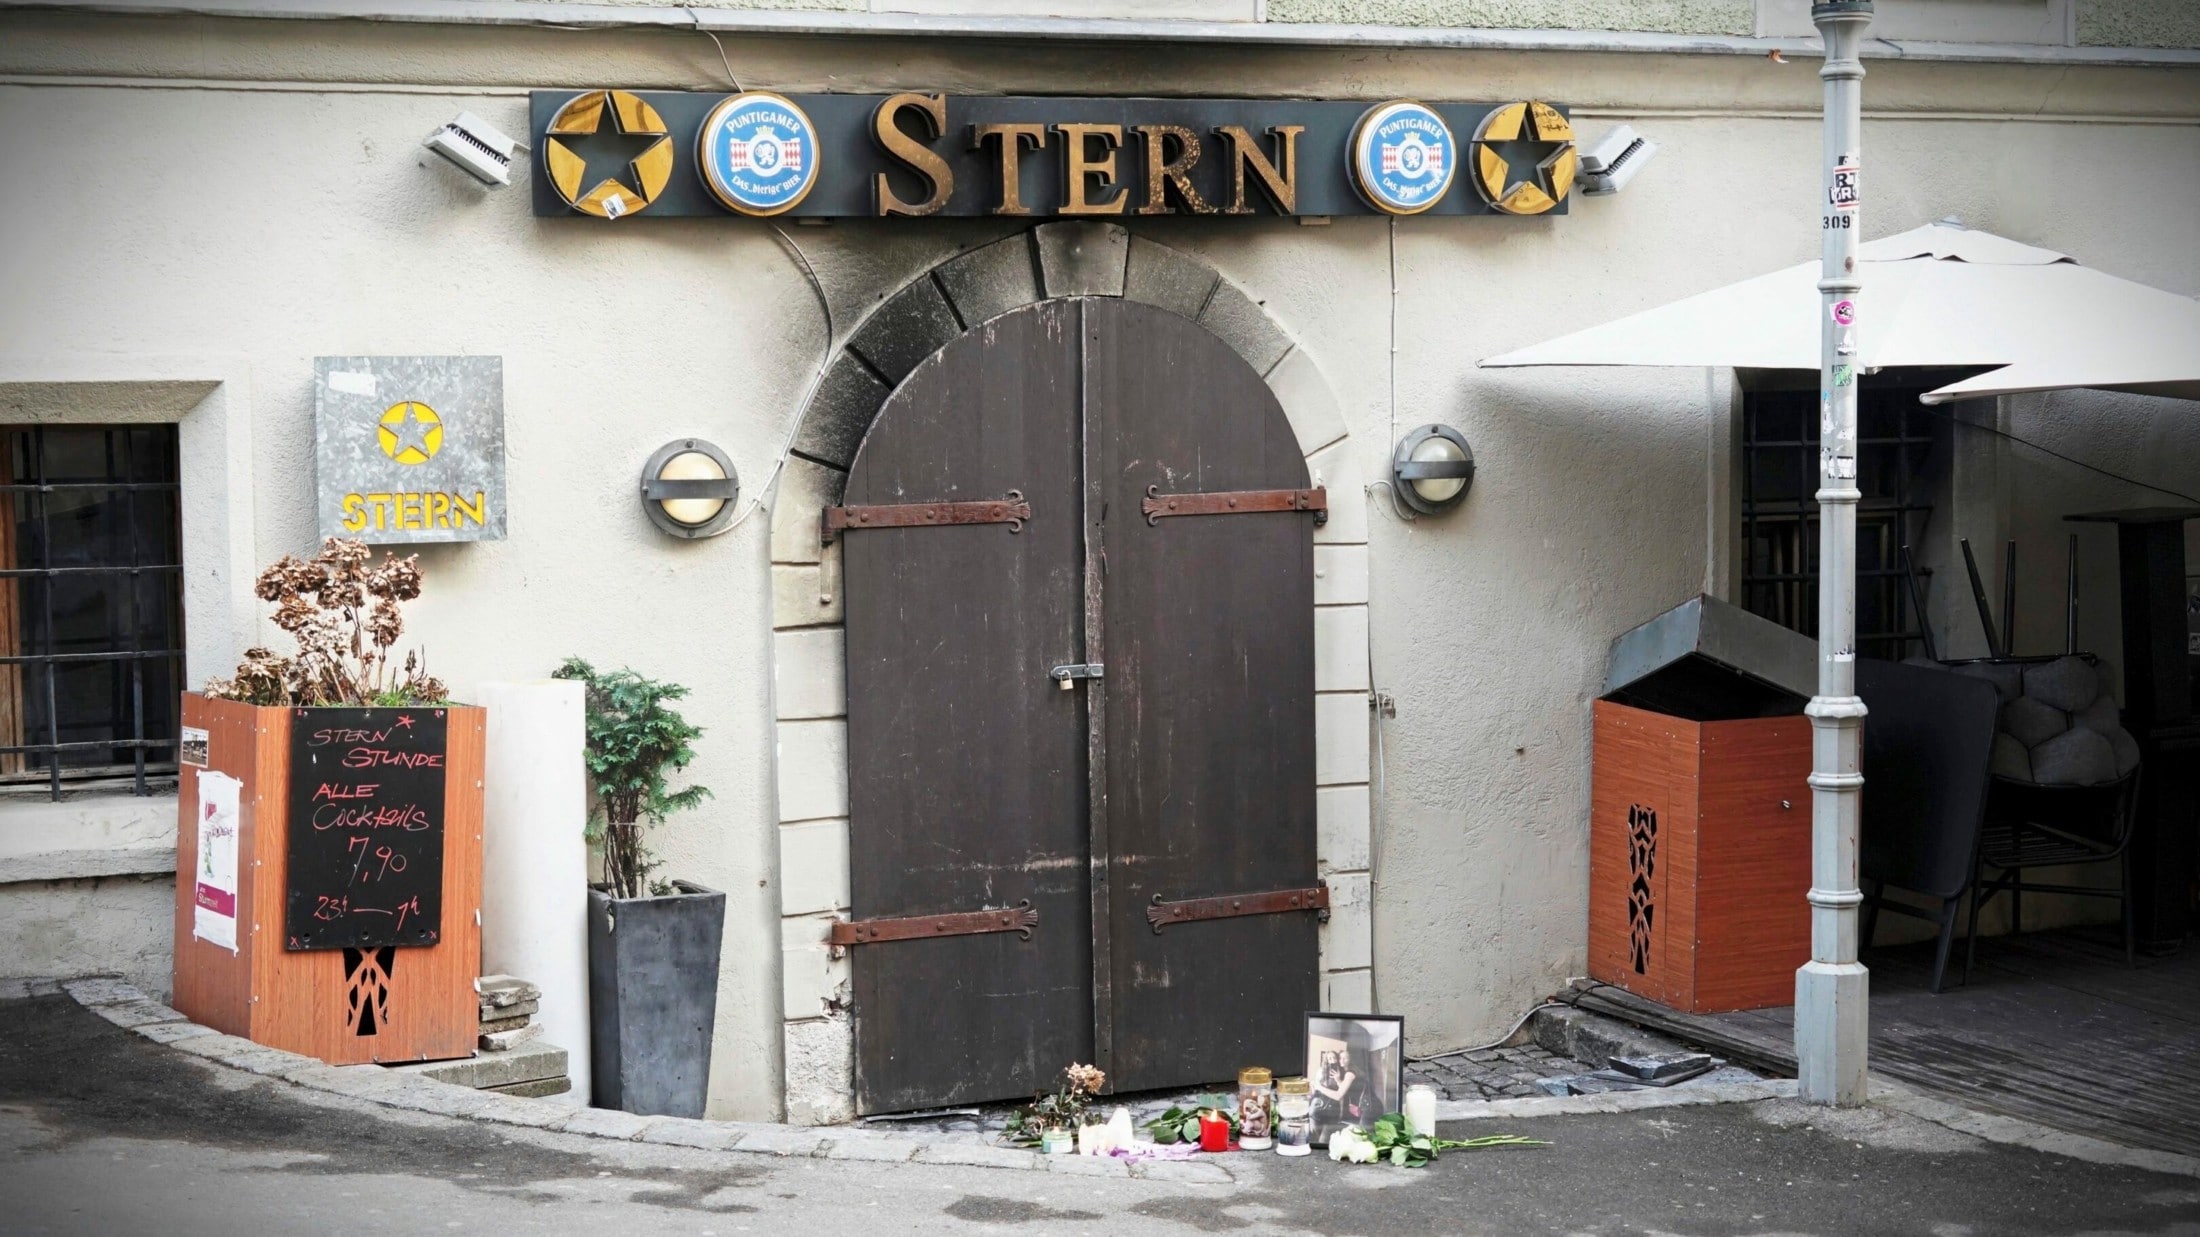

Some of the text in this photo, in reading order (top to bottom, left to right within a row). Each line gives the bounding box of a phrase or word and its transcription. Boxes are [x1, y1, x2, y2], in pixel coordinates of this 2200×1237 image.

[725, 111, 801, 135] PUNTIGAMER
[1379, 118, 1444, 140] PUNTIGAMER
[872, 93, 1305, 217] STERN
[731, 174, 749, 190] DAS
[782, 174, 801, 191] BIER
[1382, 177, 1397, 192] DAS
[1822, 214, 1851, 230] 309
[342, 491, 485, 532] STERN
[307, 727, 392, 746] STERN
[342, 747, 443, 769] STUNDE
[312, 783, 380, 801] ALLE
[348, 836, 407, 887] 7,90
